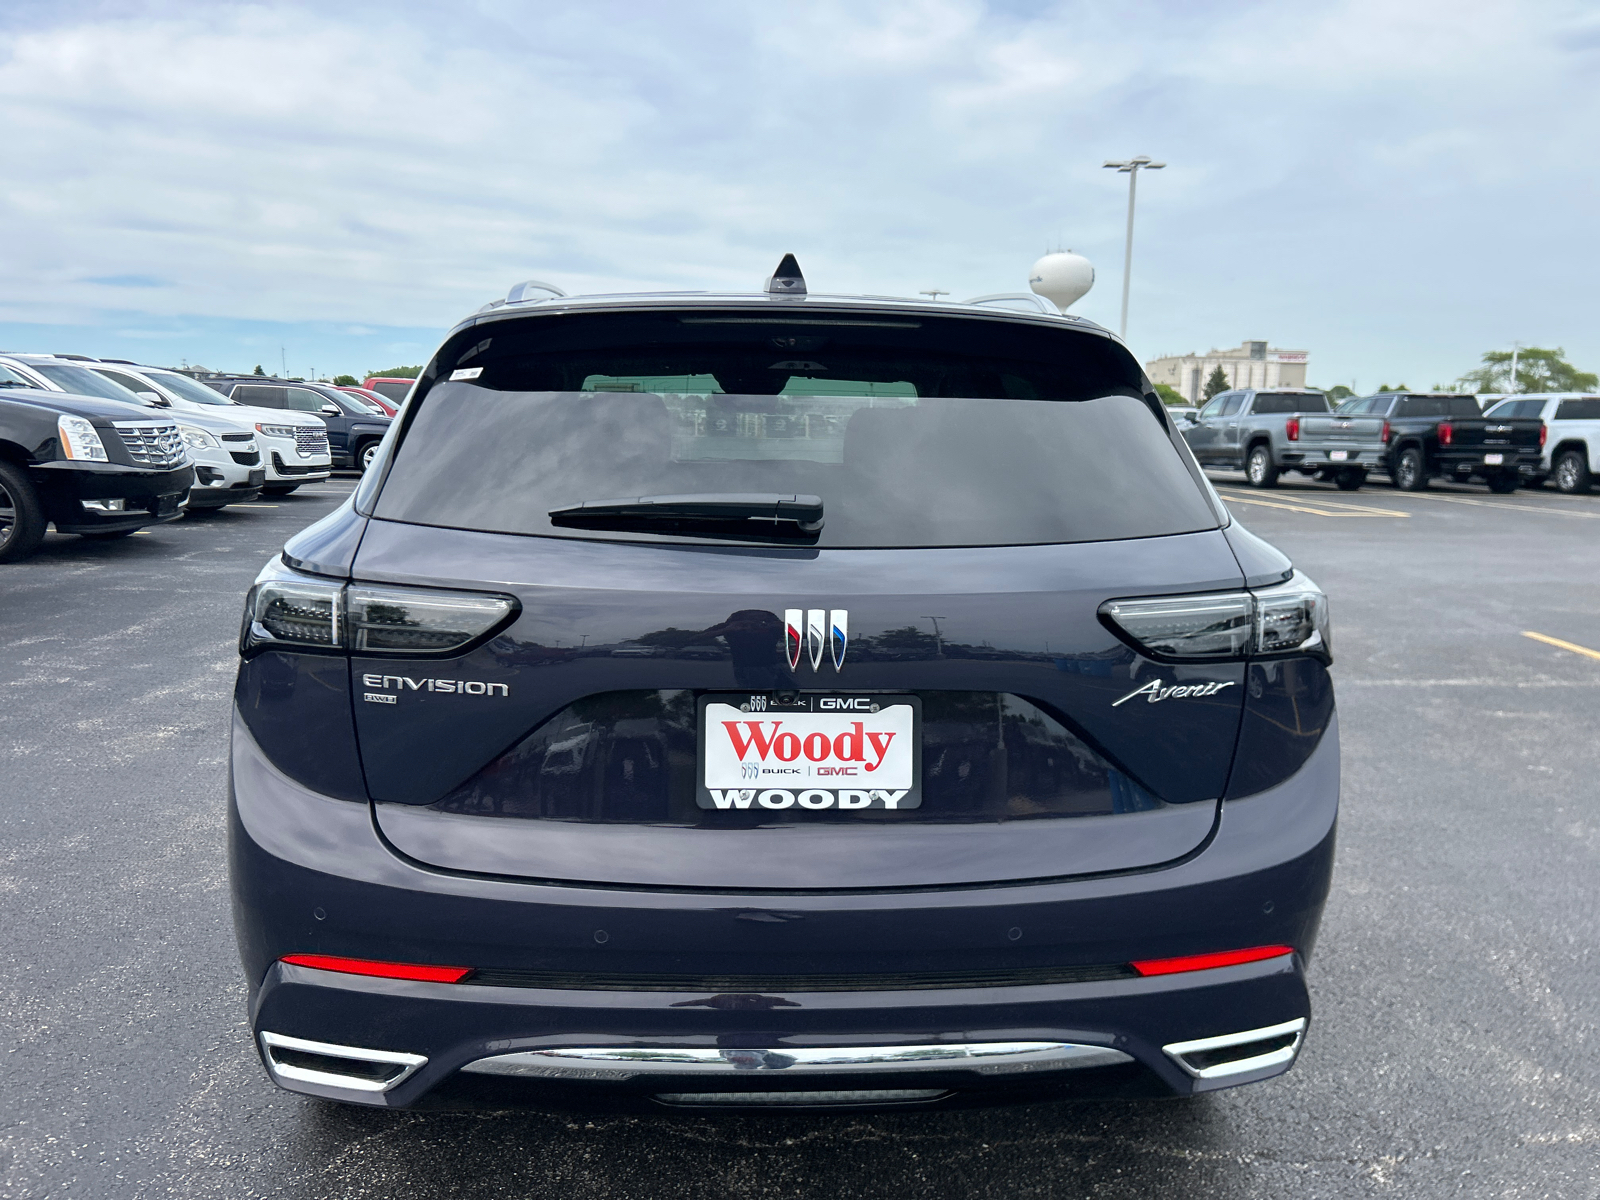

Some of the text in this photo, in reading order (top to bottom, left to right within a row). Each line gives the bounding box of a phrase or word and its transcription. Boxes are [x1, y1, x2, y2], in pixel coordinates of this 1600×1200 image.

[363, 673, 509, 697] ENVISION
[1111, 678, 1235, 707] Avenir
[820, 698, 871, 709] GMC
[721, 720, 897, 772] Woody
[816, 766, 858, 776] GMC
[709, 789, 910, 809] WOODY
